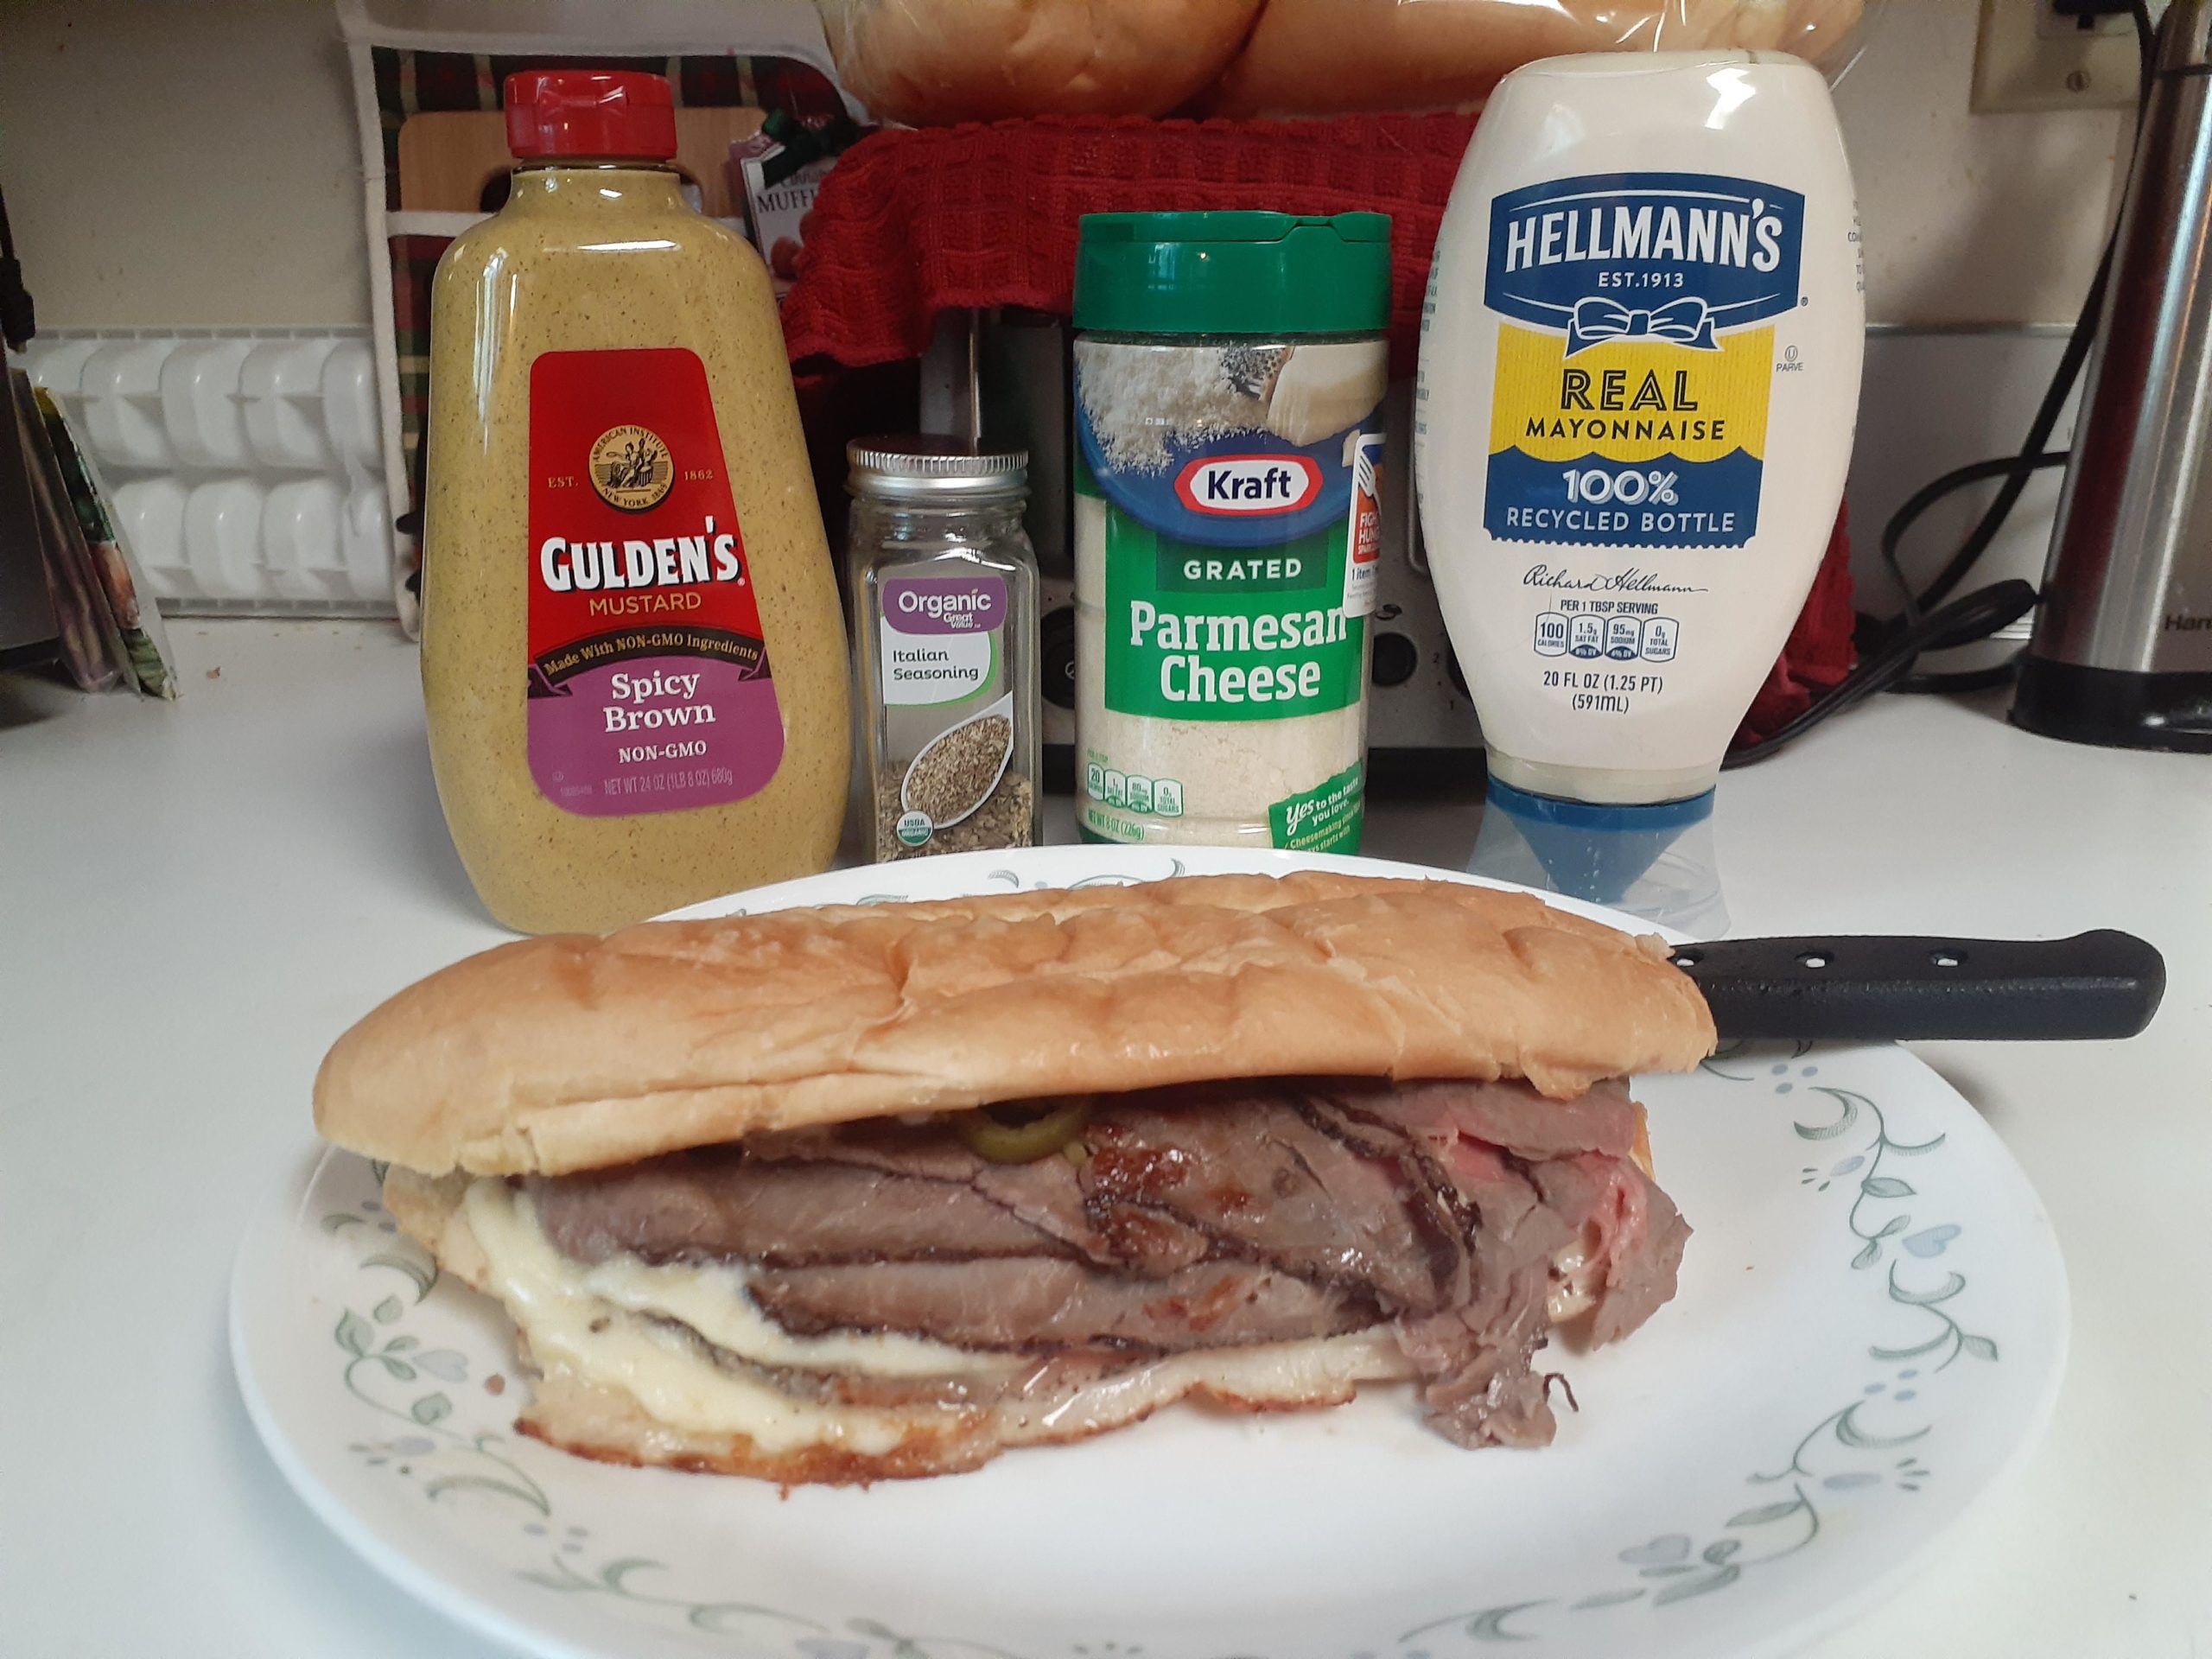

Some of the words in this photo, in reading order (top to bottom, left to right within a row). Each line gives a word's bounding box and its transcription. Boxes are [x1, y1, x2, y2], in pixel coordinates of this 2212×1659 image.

[1504, 198, 1783, 273] HELLMANN'S
[1776, 362, 1804, 372] PARVE
[1560, 369, 1699, 411] REAL
[1525, 416, 1726, 441] MAYONNAISE
[548, 476, 578, 488] EST.
[683, 469, 713, 481] 1862
[1207, 467, 1291, 500] Kraft
[1562, 469, 1680, 506] 100%
[603, 487, 620, 503] NEW
[623, 497, 649, 507] YORK
[1506, 507, 1630, 531] RECYCLED
[1641, 512, 1735, 532] BOTTLE
[540, 515, 741, 593] GULDEN'S
[1183, 558, 1303, 581] GRATED
[1523, 564, 1605, 591] Richard
[1605, 567, 1709, 593] Hellmann
[589, 592, 702, 616] MUSTARD
[899, 589, 992, 619] Organic
[1560, 599, 1580, 612] PER
[1582, 601, 1586, 612] 1
[1590, 601, 1615, 613] TBSP
[1617, 602, 1659, 614] SERVING
[944, 612, 973, 623] Great
[1130, 600, 1348, 652] Parmesan
[1541, 622, 1564, 639] 100
[1610, 636, 1635, 645] SODIUM
[1649, 638, 1669, 646] TOTAL
[543, 653, 580, 677] Made
[580, 641, 614, 660] With
[615, 632, 683, 652] NON-GMO
[687, 633, 759, 661] Ingredients
[893, 648, 950, 663] Italian
[1537, 639, 1565, 648] CALORIES
[893, 665, 979, 681] Seasoning
[1160, 653, 1321, 703] Cheese
[1543, 670, 1559, 687] 20
[1564, 671, 1579, 688] FL
[1583, 673, 1599, 690] OZ
[1604, 673, 1637, 692] (1.25
[1641, 676, 1663, 695] PT)
[610, 670, 701, 704] Spicy
[603, 702, 716, 733] Brown
[619, 740, 708, 764] NON-GMO
[605, 778, 622, 795] NET
[624, 777, 639, 793] WT
[639, 776, 651, 791] 24
[654, 773, 665, 790] OZ
[667, 771, 686, 791] (1LB
[696, 770, 709, 788] OZ)
[711, 767, 733, 785] 680g
[1316, 800, 1327, 810] to
[1328, 790, 1342, 804] the
[904, 818, 925, 827] USDA
[1312, 811, 1331, 827] you
[1290, 820, 1342, 849] Cheesemaking
